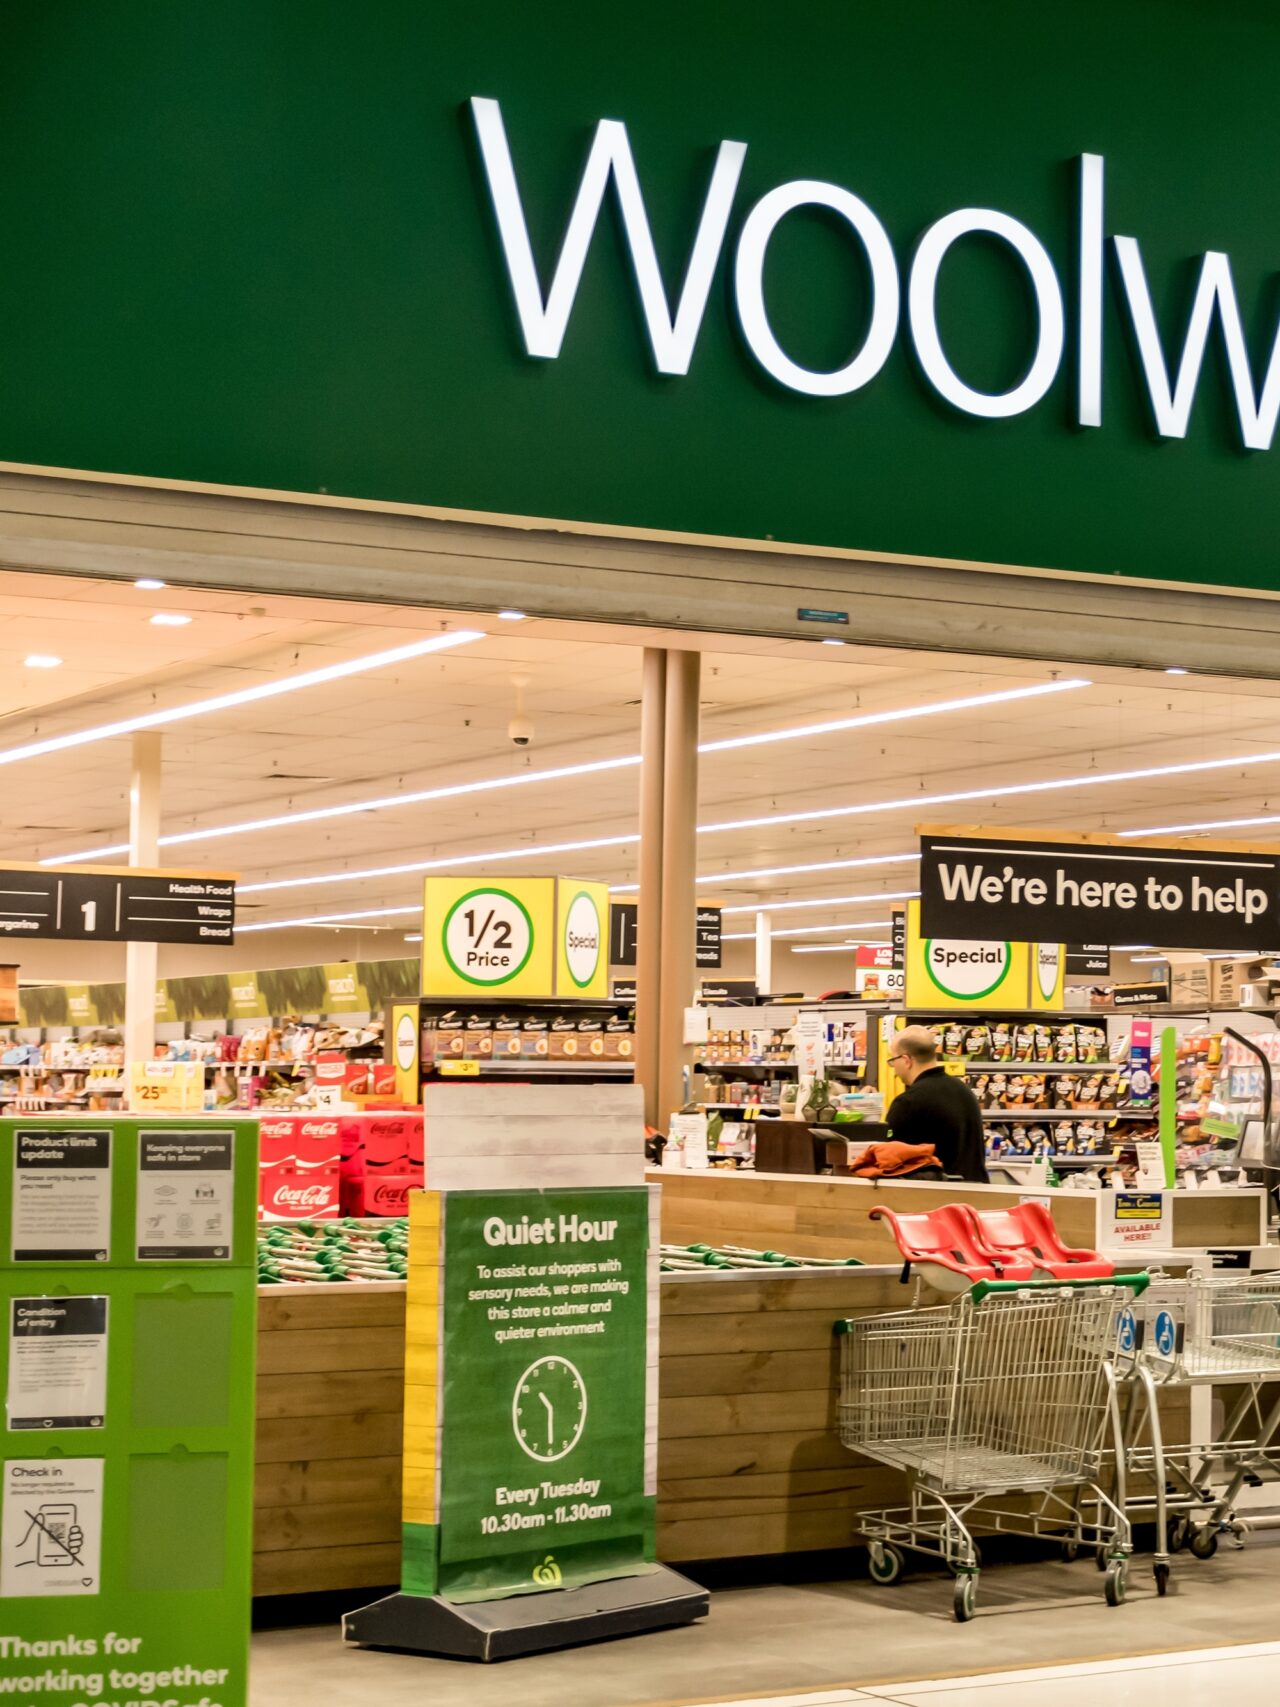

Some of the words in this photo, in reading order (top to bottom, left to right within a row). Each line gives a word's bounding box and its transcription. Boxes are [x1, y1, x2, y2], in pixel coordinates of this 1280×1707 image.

[206, 885, 232, 896] Food
[938, 863, 1047, 905] We're
[1056, 869, 1137, 910] here
[1145, 877, 1183, 909] to
[1192, 876, 1268, 923] help
[81, 901, 96, 932] 1
[198, 906, 231, 917] Wraps
[696, 913, 718, 923] offee
[200, 926, 230, 937] Bread
[464, 909, 512, 949] 1/2
[701, 932, 718, 942] Tea
[568, 931, 597, 952] Special
[467, 952, 510, 967] Price
[934, 947, 1003, 967] Special
[1086, 959, 1107, 969] Juice
[21, 1137, 68, 1147] Product
[70, 1137, 97, 1147] limit
[146, 1144, 183, 1154] Keeping
[21, 1150, 64, 1161] update
[483, 1215, 555, 1246] Quiet
[559, 1214, 617, 1243] Hour
[1114, 1223, 1160, 1234] AVAILABLE
[477, 1265, 491, 1279] To
[493, 1264, 527, 1279] assist
[528, 1264, 548, 1277] our
[548, 1261, 597, 1277] shoppers
[598, 1259, 621, 1272] with
[468, 1288, 513, 1302] sensory
[515, 1283, 552, 1298] needs,
[553, 1284, 569, 1295] we
[571, 1283, 588, 1294] are
[590, 1279, 629, 1294] making
[17, 1308, 66, 1317] Condition
[488, 1306, 509, 1320] this
[511, 1306, 540, 1319] store
[543, 1307, 550, 1316] a
[552, 1302, 589, 1315] calmer
[590, 1299, 612, 1313] and
[17, 1319, 28, 1327] of
[29, 1319, 56, 1328] entry
[495, 1326, 535, 1343] quieter
[537, 1321, 605, 1338] environment
[11, 1466, 48, 1477] Check
[52, 1467, 62, 1476] in
[496, 1487, 539, 1506] Every
[541, 1478, 601, 1500] Tuesday
[481, 1514, 545, 1534] 10.30am
[555, 1503, 612, 1523] 11.30am
[0, 1634, 97, 1658] Thanks
[102, 1632, 142, 1654] for
[0, 1669, 103, 1696] working
[108, 1664, 229, 1694] together
